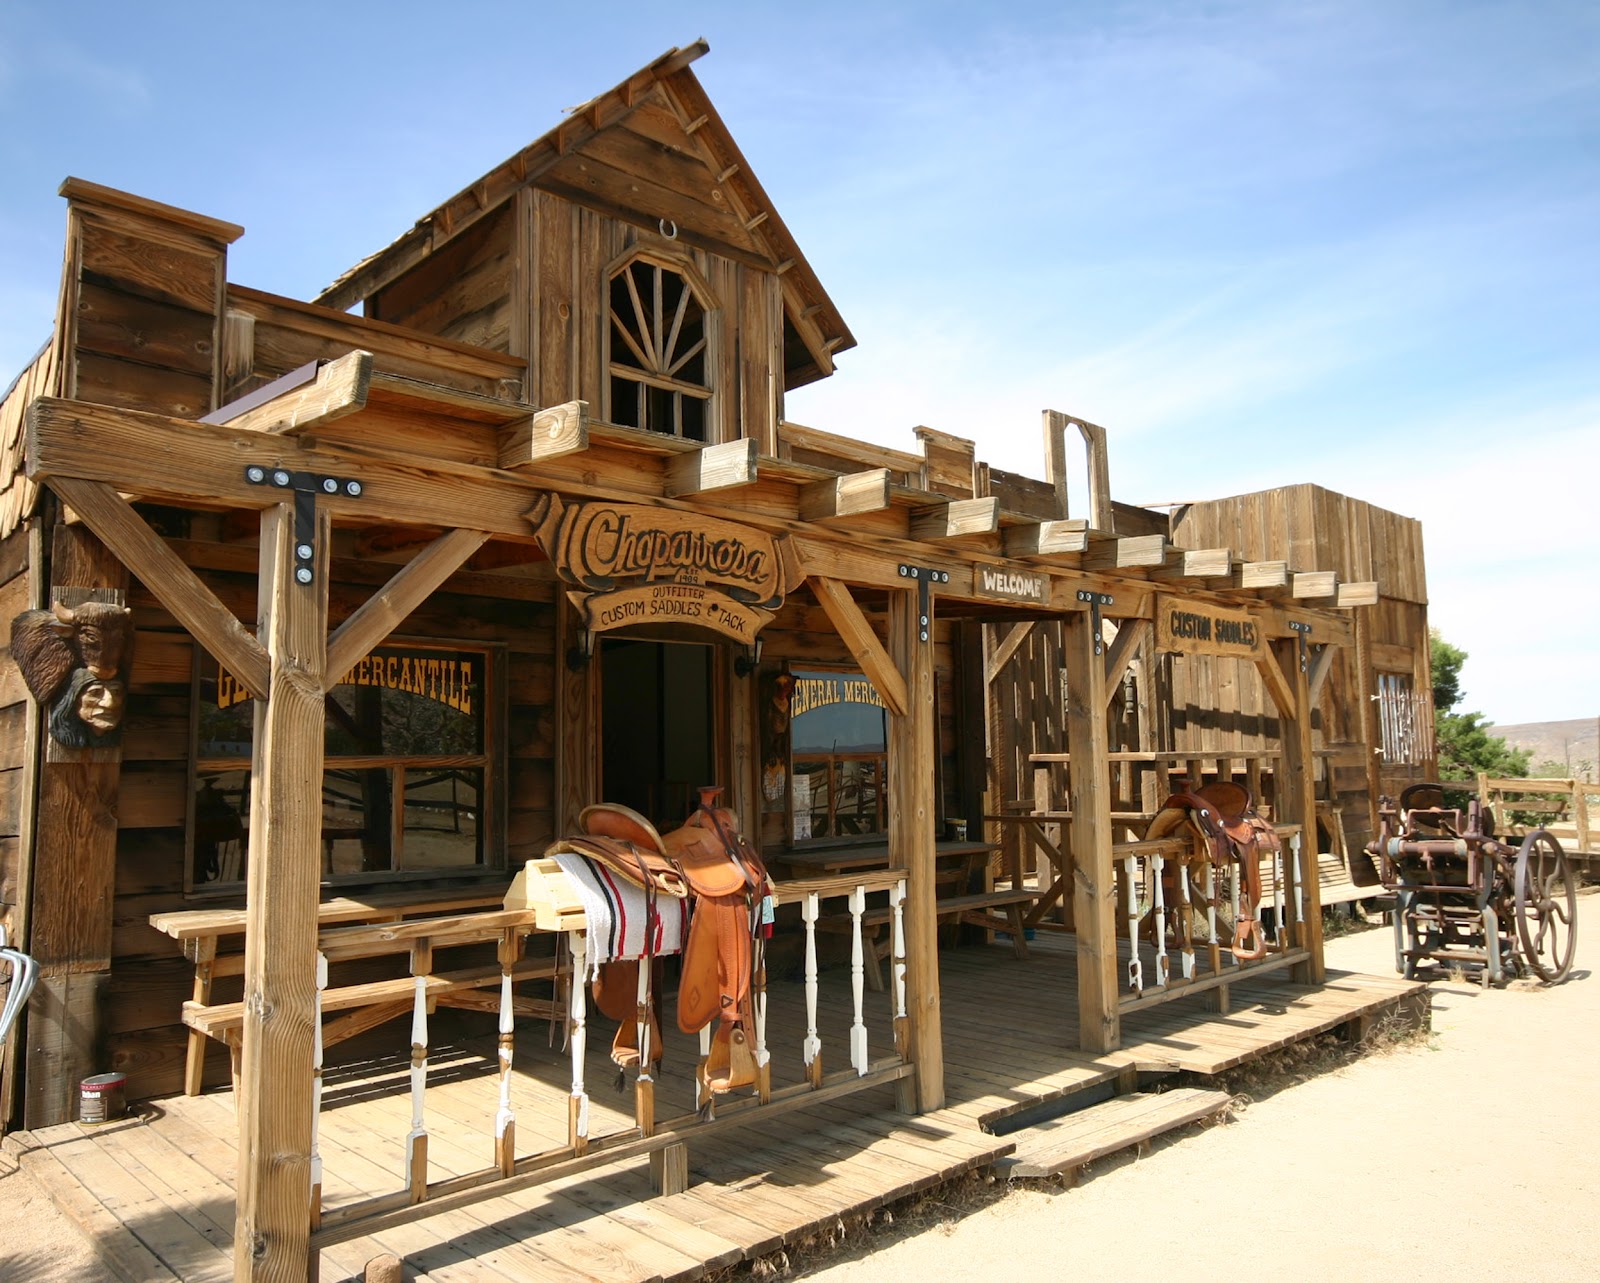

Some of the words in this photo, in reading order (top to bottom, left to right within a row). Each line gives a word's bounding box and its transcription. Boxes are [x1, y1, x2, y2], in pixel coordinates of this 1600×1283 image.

[585, 509, 769, 583] Chaparrosa
[652, 586, 705, 600] OUTFITTER
[983, 570, 1042, 598] WELCOME
[601, 601, 645, 626] CUSTOM
[650, 600, 702, 617] SADDLES
[718, 608, 746, 633] TACK
[1170, 610, 1211, 641] CUSTOM
[1215, 618, 1255, 646] SADDLES
[791, 679, 840, 718] ENERAL
